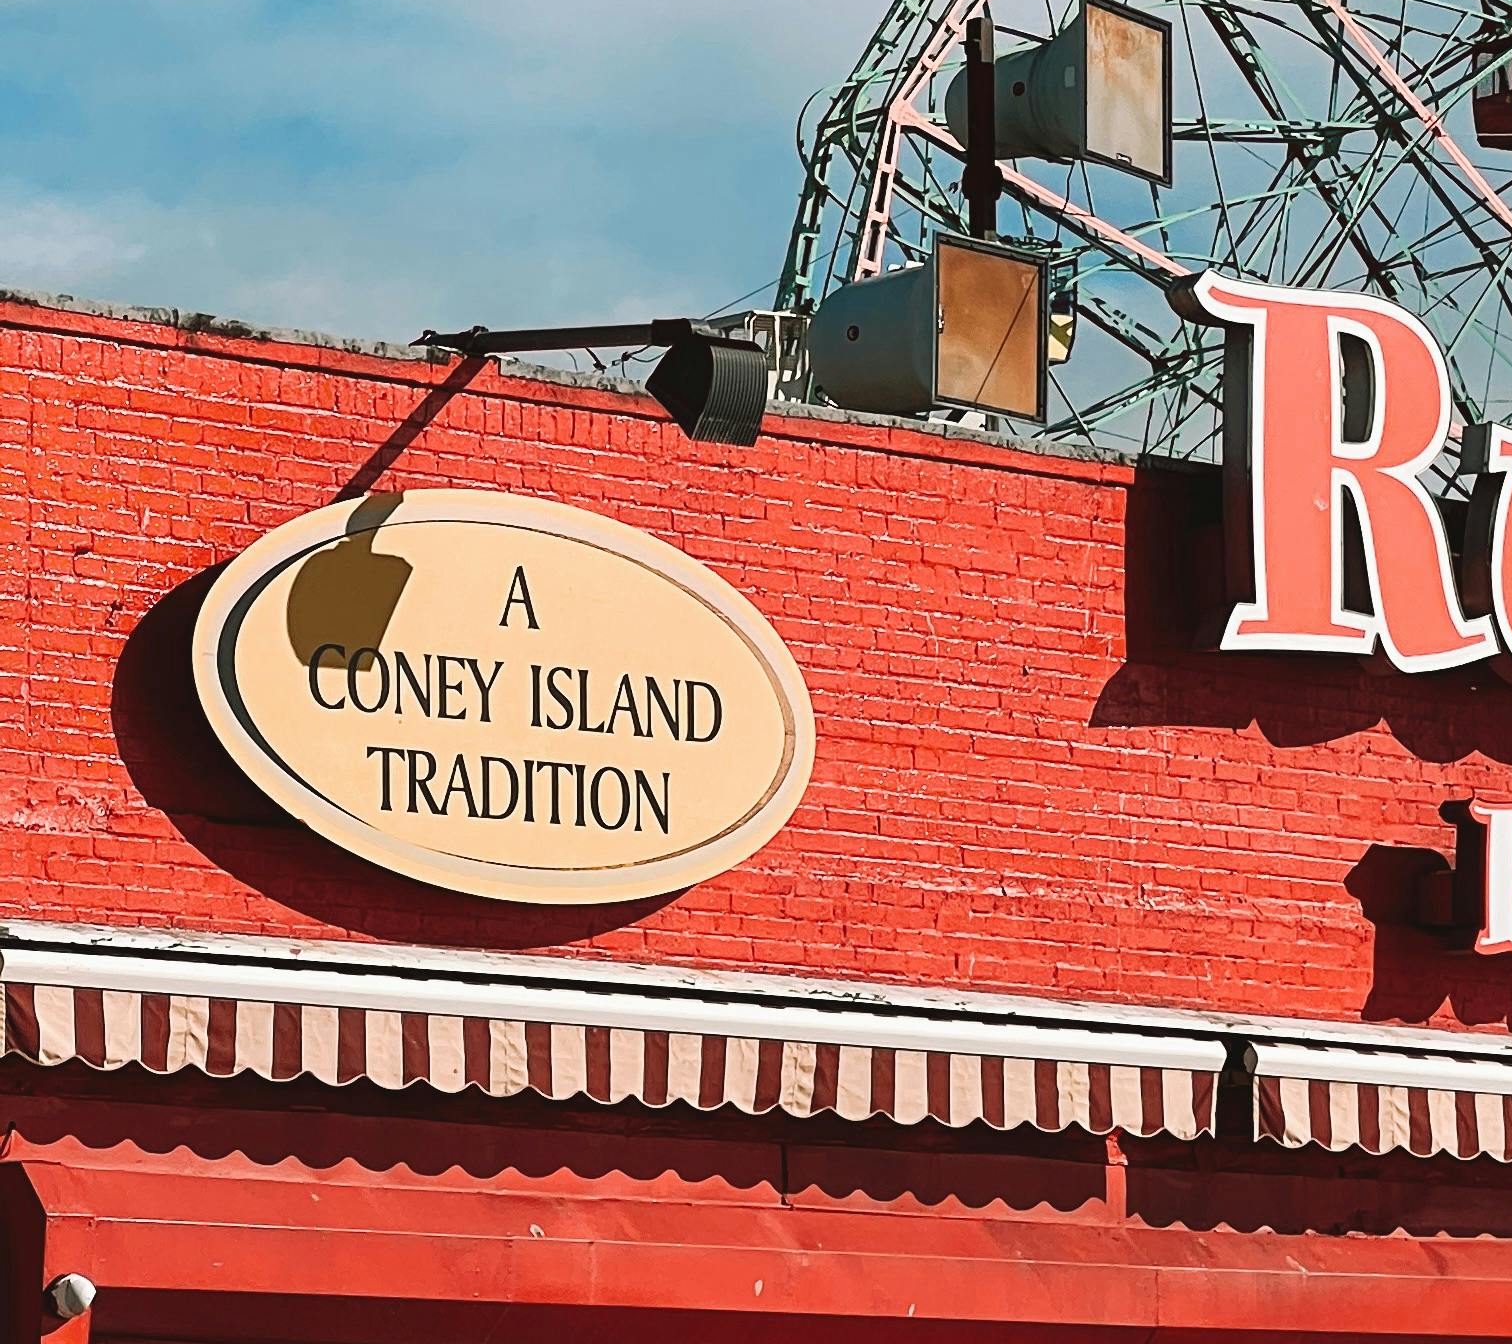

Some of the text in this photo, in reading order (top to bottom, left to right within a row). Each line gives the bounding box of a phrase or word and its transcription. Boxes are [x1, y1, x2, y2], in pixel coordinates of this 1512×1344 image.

[498, 565, 541, 630] A
[308, 643, 724, 744] CONEY ISLAND
[366, 746, 671, 836] TRADITION
